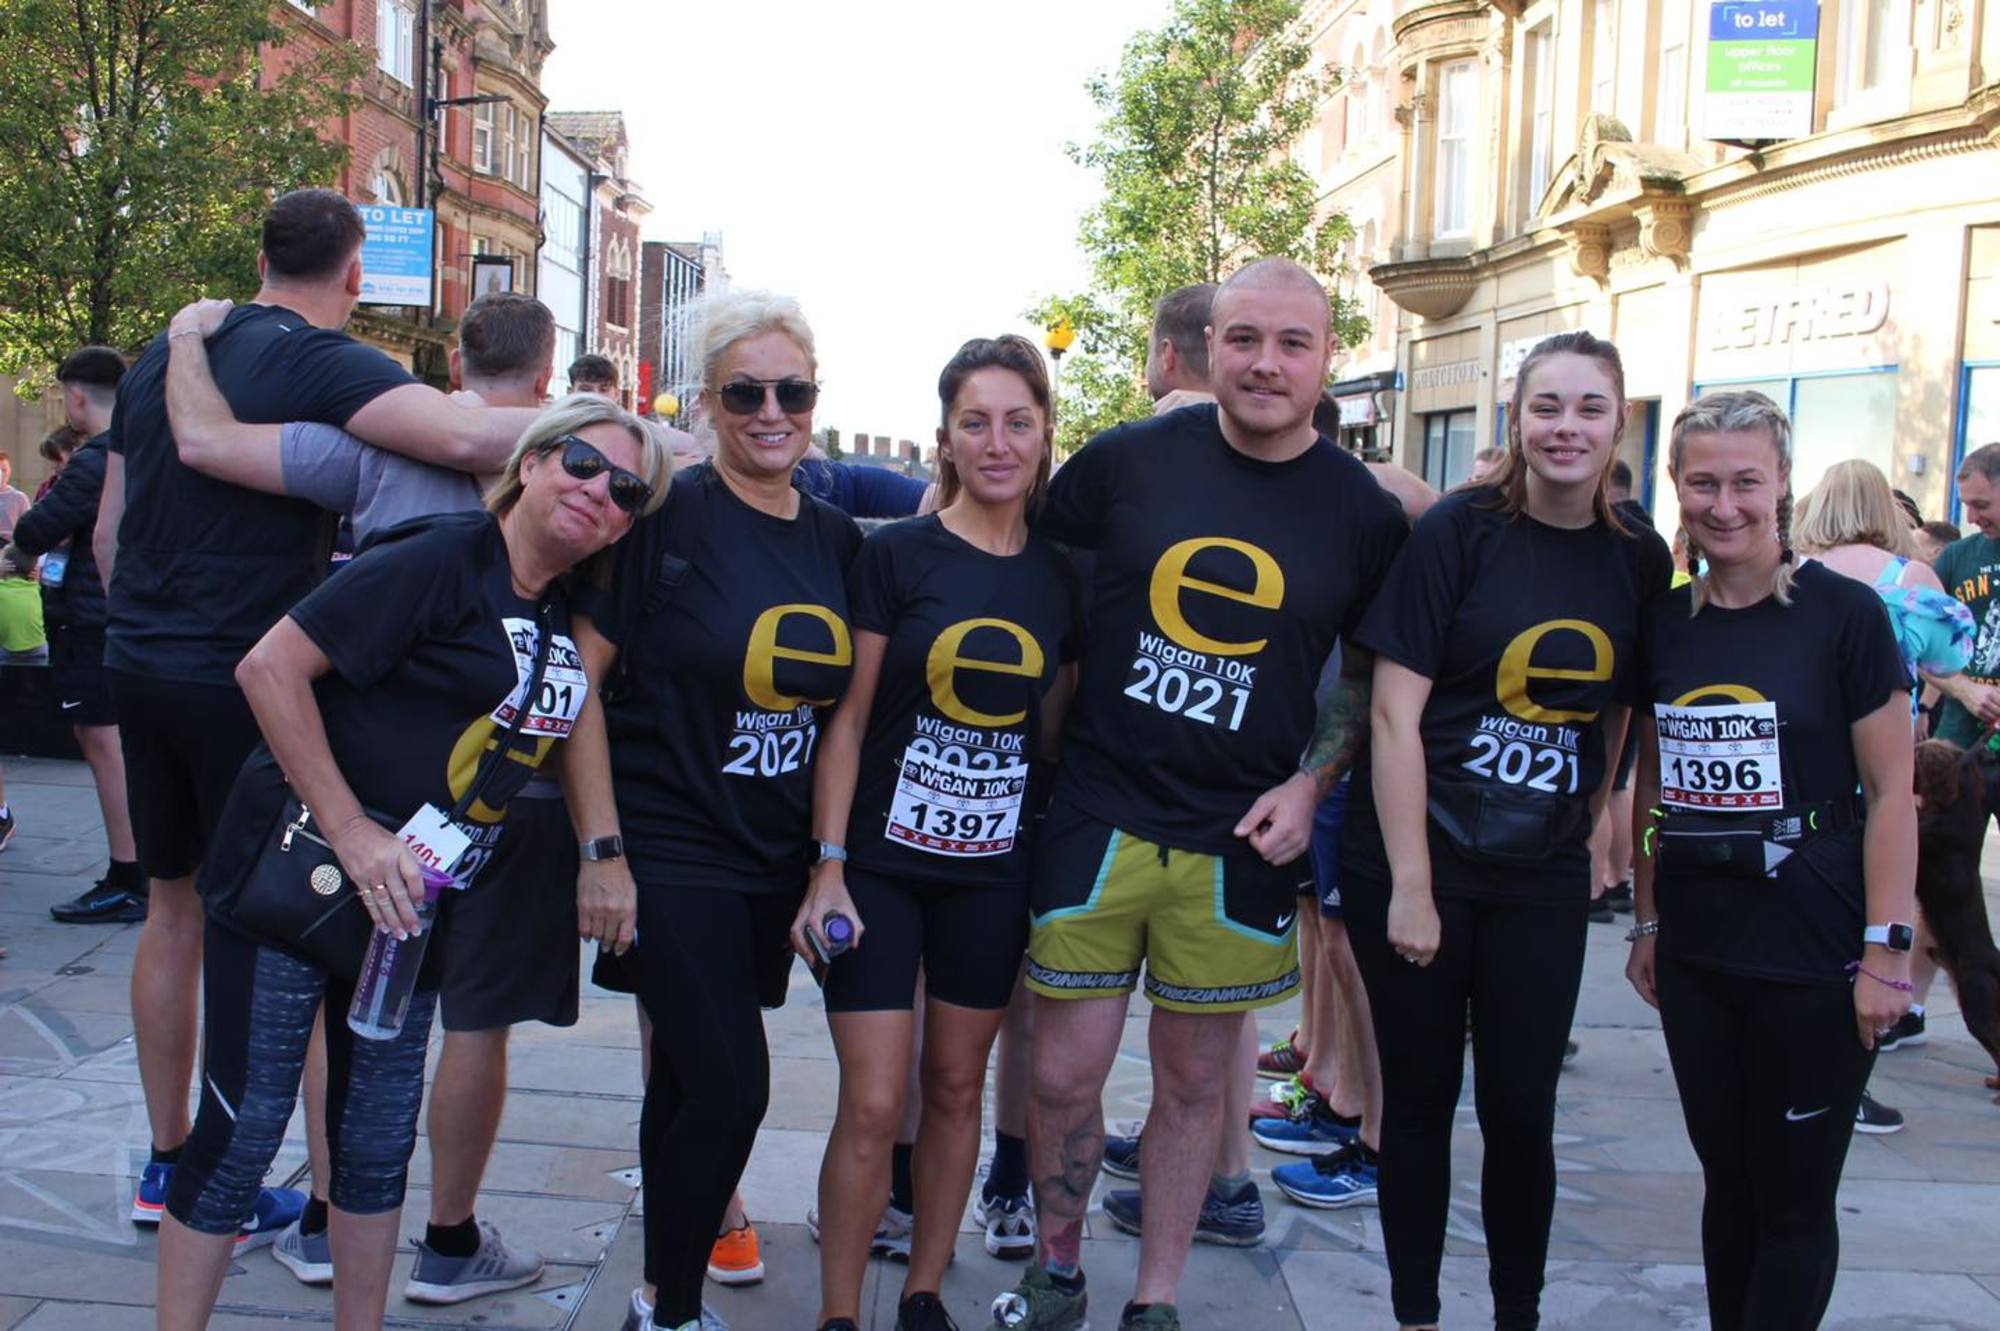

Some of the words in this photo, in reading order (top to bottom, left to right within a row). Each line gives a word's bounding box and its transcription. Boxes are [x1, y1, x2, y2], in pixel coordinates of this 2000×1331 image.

[1734, 12, 1754, 28] to
[1758, 10, 1785, 27] let
[1725, 48, 1763, 58] upper
[1766, 45, 1798, 56] floor
[359, 208, 386, 222] TO
[391, 210, 425, 224] LET
[1711, 279, 1890, 351] BETFRED
[1149, 536, 1286, 656] e
[547, 647, 571, 666] 0K
[743, 603, 853, 711] e
[926, 617, 1044, 727] e
[1138, 631, 1207, 670] Wigan
[1215, 657, 1257, 684] 10K
[1496, 618, 1615, 724] e
[536, 680, 572, 717] 01
[1123, 656, 1250, 731] 2021
[736, 711, 792, 733] Wigan
[916, 714, 983, 743] Wigan
[991, 731, 1025, 751] 10K
[1479, 715, 1547, 740] Wigan
[1556, 726, 1580, 749] 10K
[1717, 718, 1757, 739] 10K
[722, 725, 817, 777] 2021
[911, 737, 1021, 771] 202
[1461, 734, 1579, 794] 2021
[981, 780, 1011, 797] 10K
[1671, 756, 1762, 791] 1396
[909, 802, 1007, 840] 1397
